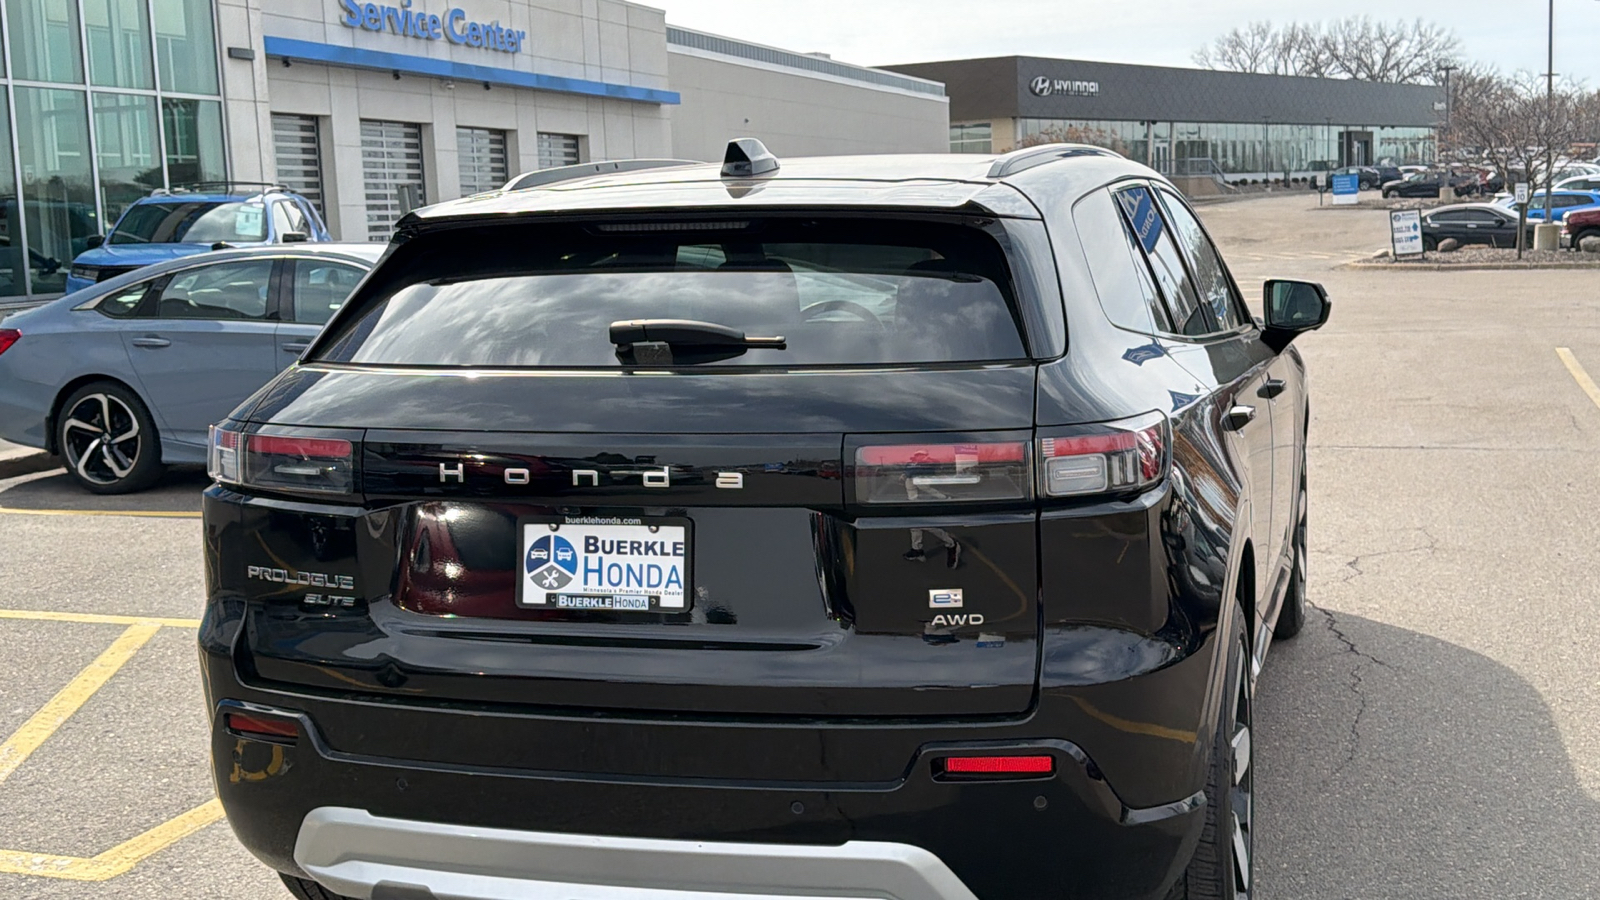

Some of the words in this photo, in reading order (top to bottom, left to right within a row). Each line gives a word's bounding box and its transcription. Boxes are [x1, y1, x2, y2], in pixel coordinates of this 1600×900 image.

[340, 0, 442, 40] Service
[443, 7, 526, 53] Center
[565, 516, 642, 525] buerklehonda.com
[584, 535, 684, 557] BUERKLE
[247, 565, 354, 590] PROLOGUE
[583, 556, 683, 589] HONDA
[303, 593, 355, 607] ELITE
[931, 613, 984, 626] AWD
